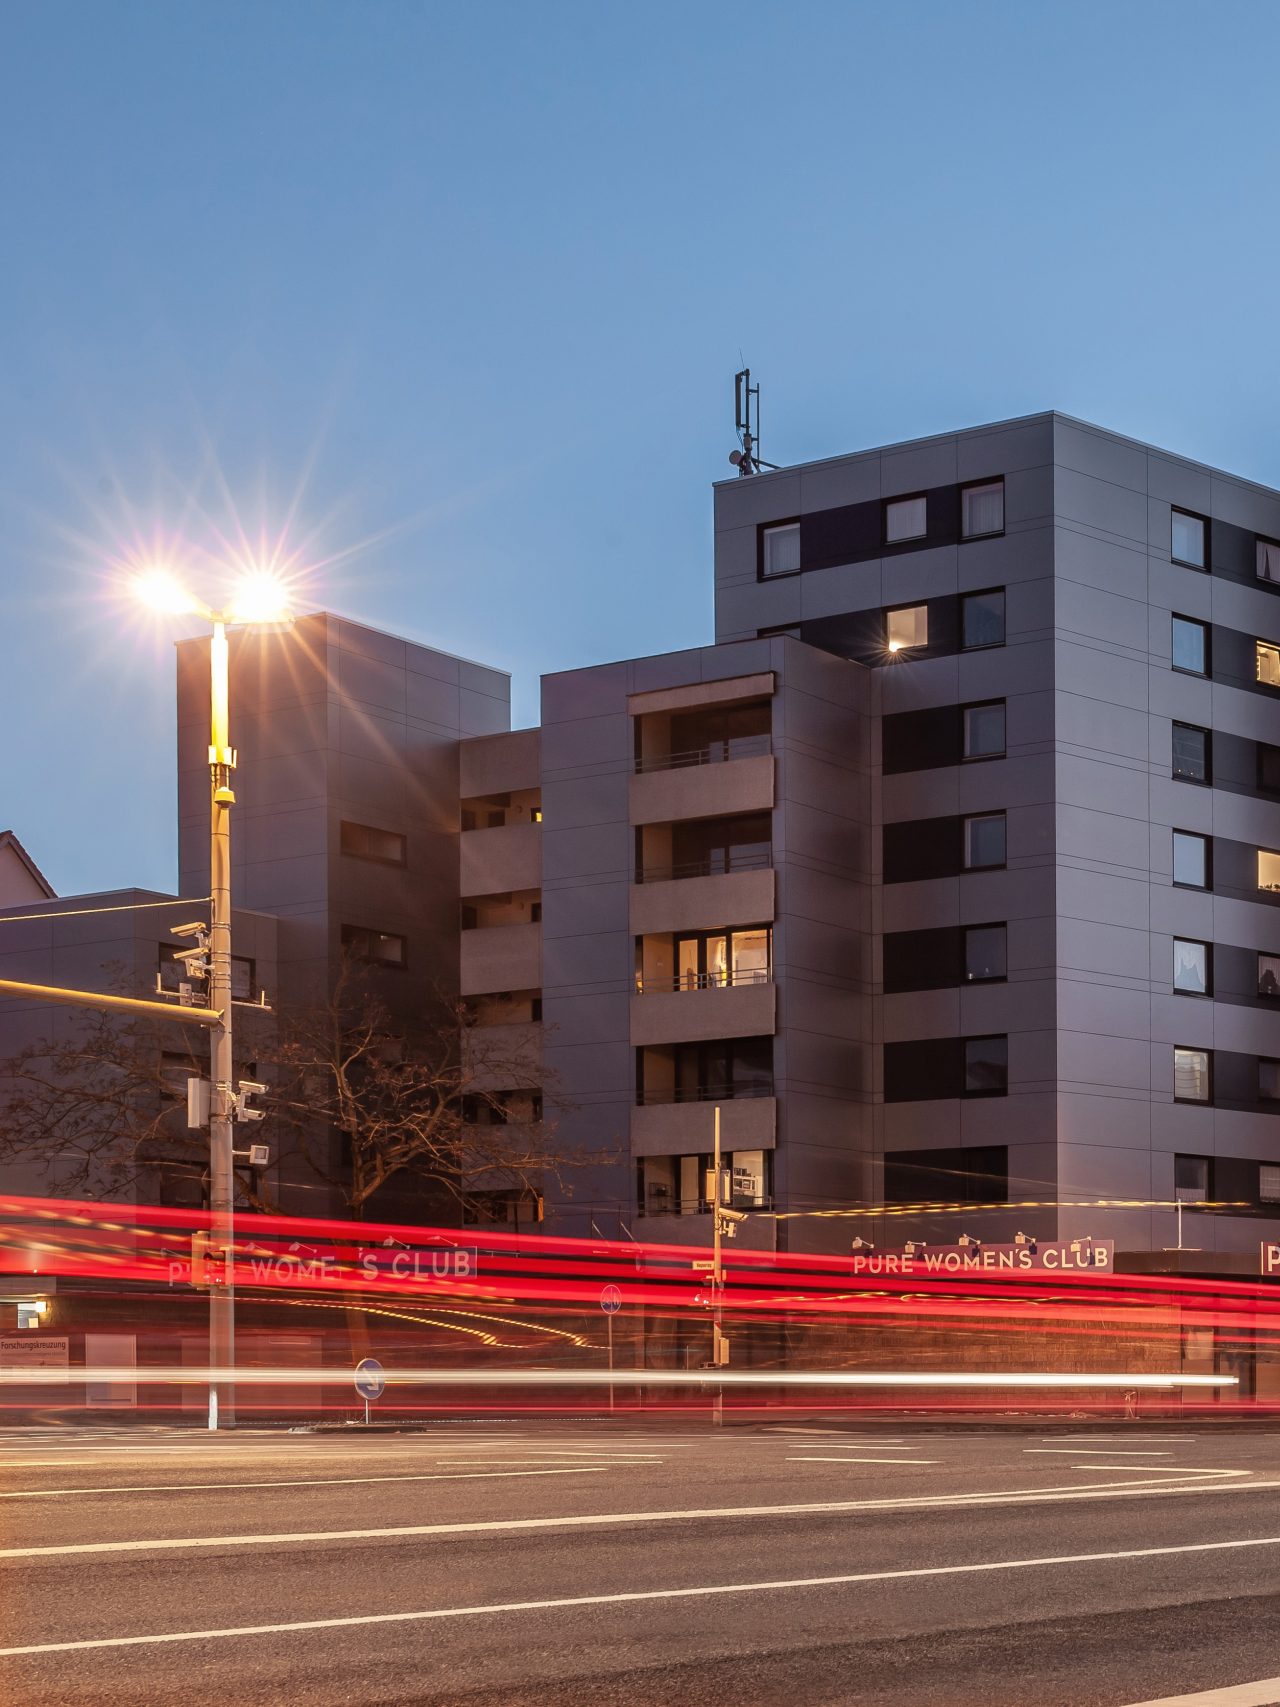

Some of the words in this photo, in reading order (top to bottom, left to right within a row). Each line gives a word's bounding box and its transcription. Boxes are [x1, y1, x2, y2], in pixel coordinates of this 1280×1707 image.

[392, 1249, 470, 1279] CLUB
[854, 1253, 914, 1274] PURE
[924, 1249, 1032, 1273] WOMEN'S
[1042, 1248, 1108, 1269] CLUB
[1, 1340, 66, 1351] Forschungskreuzung
